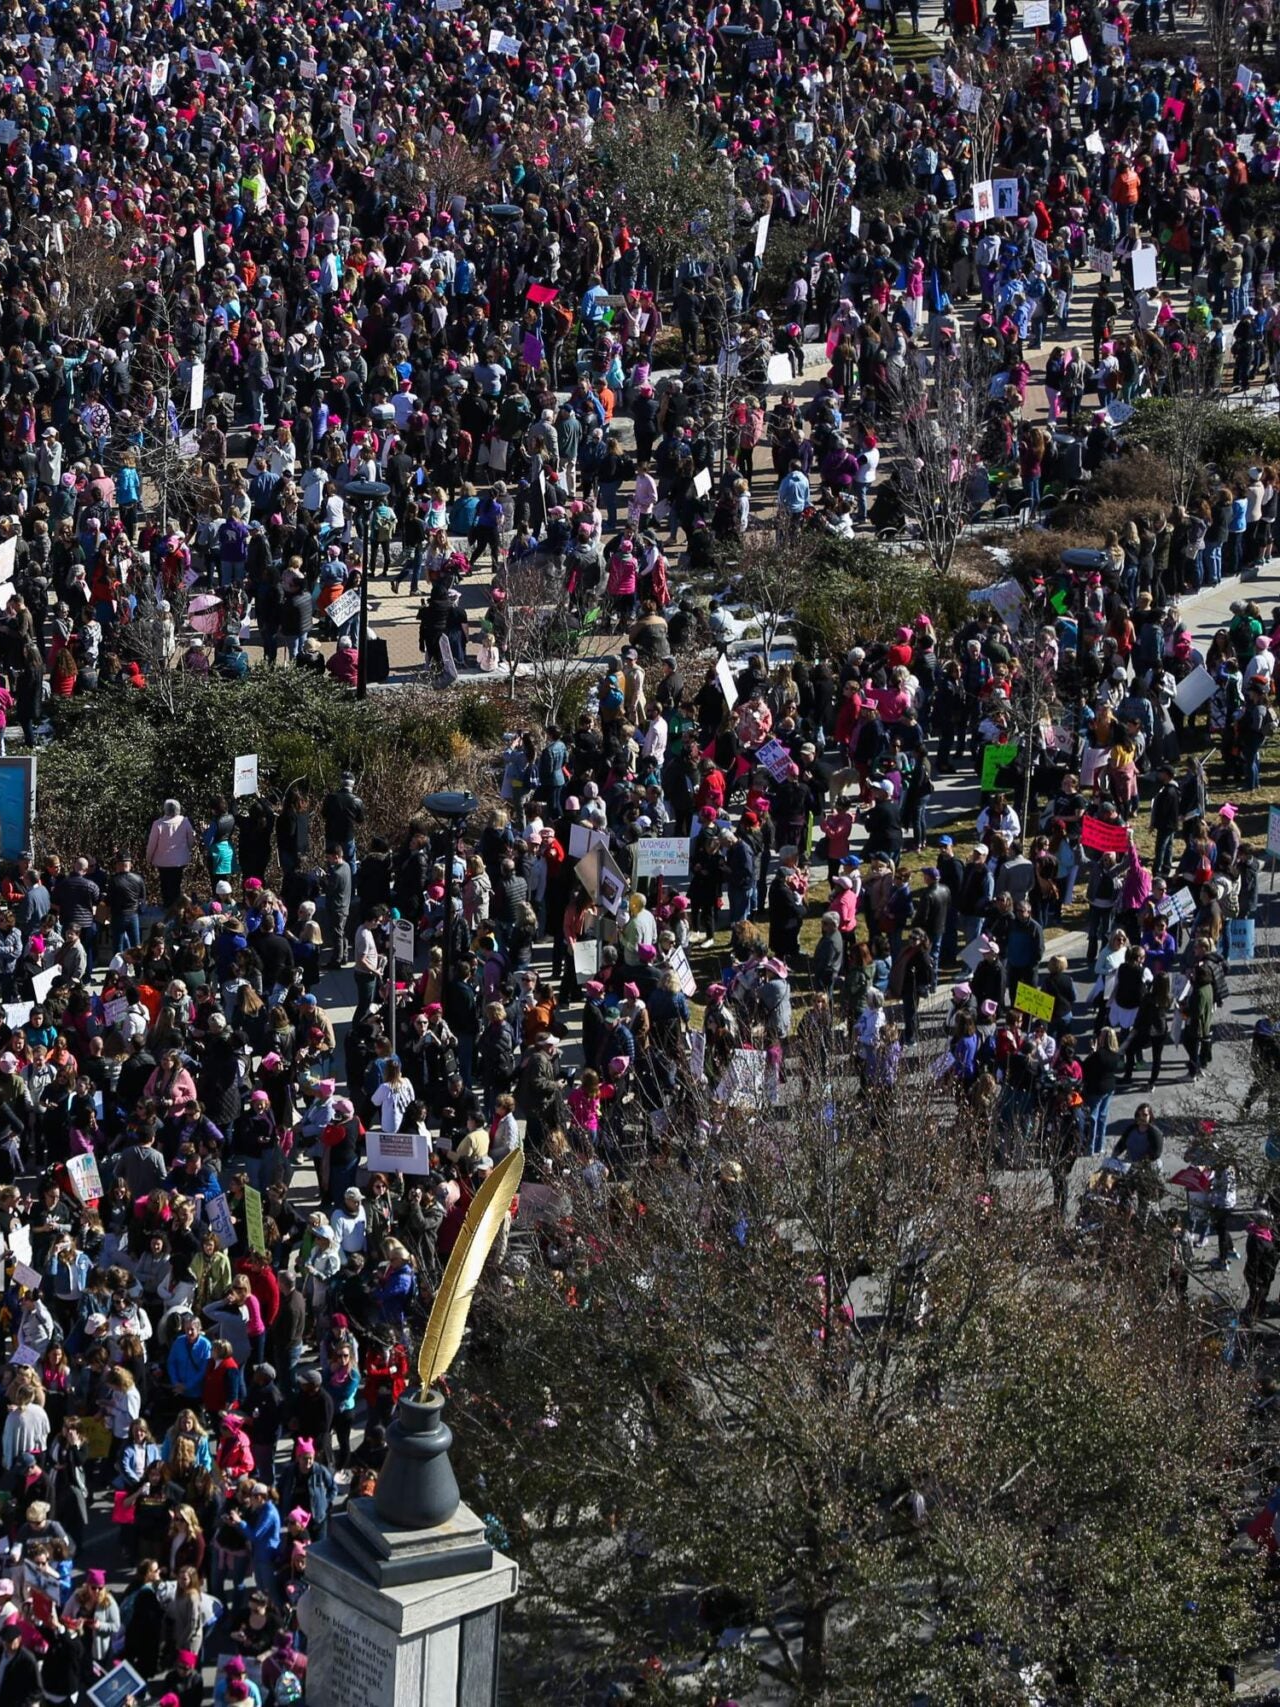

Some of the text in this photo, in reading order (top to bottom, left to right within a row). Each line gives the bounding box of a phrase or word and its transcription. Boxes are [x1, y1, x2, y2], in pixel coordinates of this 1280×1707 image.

[640, 840, 670, 849] WOMEN
[315, 1607, 393, 1659] Our biggest struggle
[333, 1632, 351, 1647] with
[350, 1652, 383, 1681] knowing
